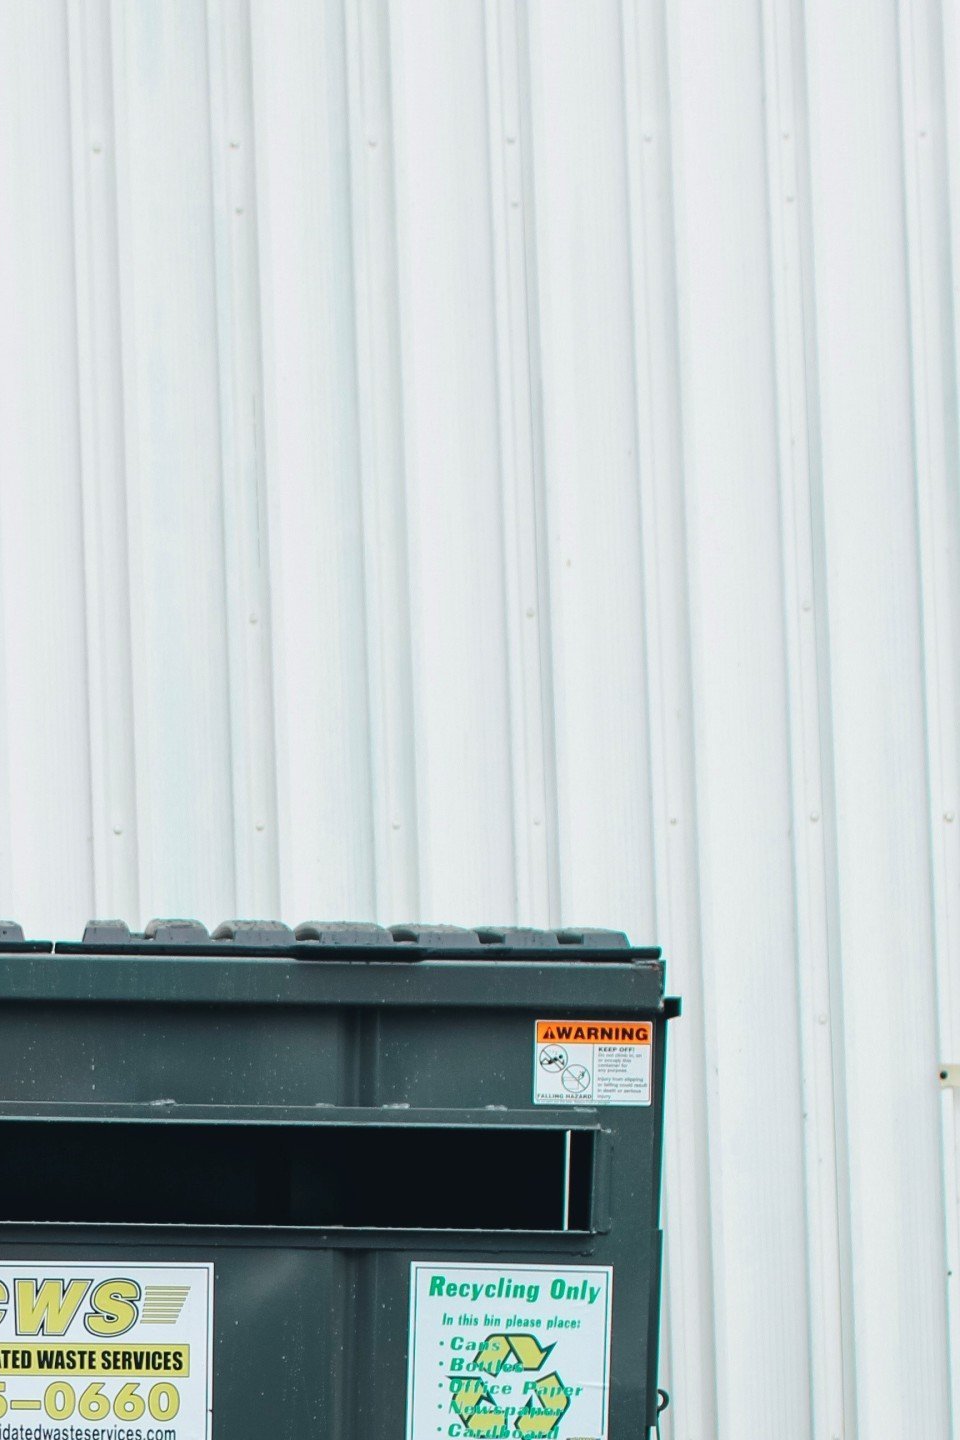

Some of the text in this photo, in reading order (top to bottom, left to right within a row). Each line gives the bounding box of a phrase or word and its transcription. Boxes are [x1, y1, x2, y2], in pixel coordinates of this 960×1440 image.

[556, 1026, 648, 1041] WARNING
[429, 1275, 601, 1304] Recycling Only
[442, 1312, 581, 1330] In this bin please place:
[450, 1336, 501, 1351] Cans
[37, 1349, 97, 1370] WASTE
[102, 1350, 184, 1371] SERVICES
[449, 1357, 524, 1373] Bottles
[449, 1379, 583, 1397] Office Paper
[449, 1400, 565, 1418] Newspaper
[447, 1423, 560, 1440] Cardboard
